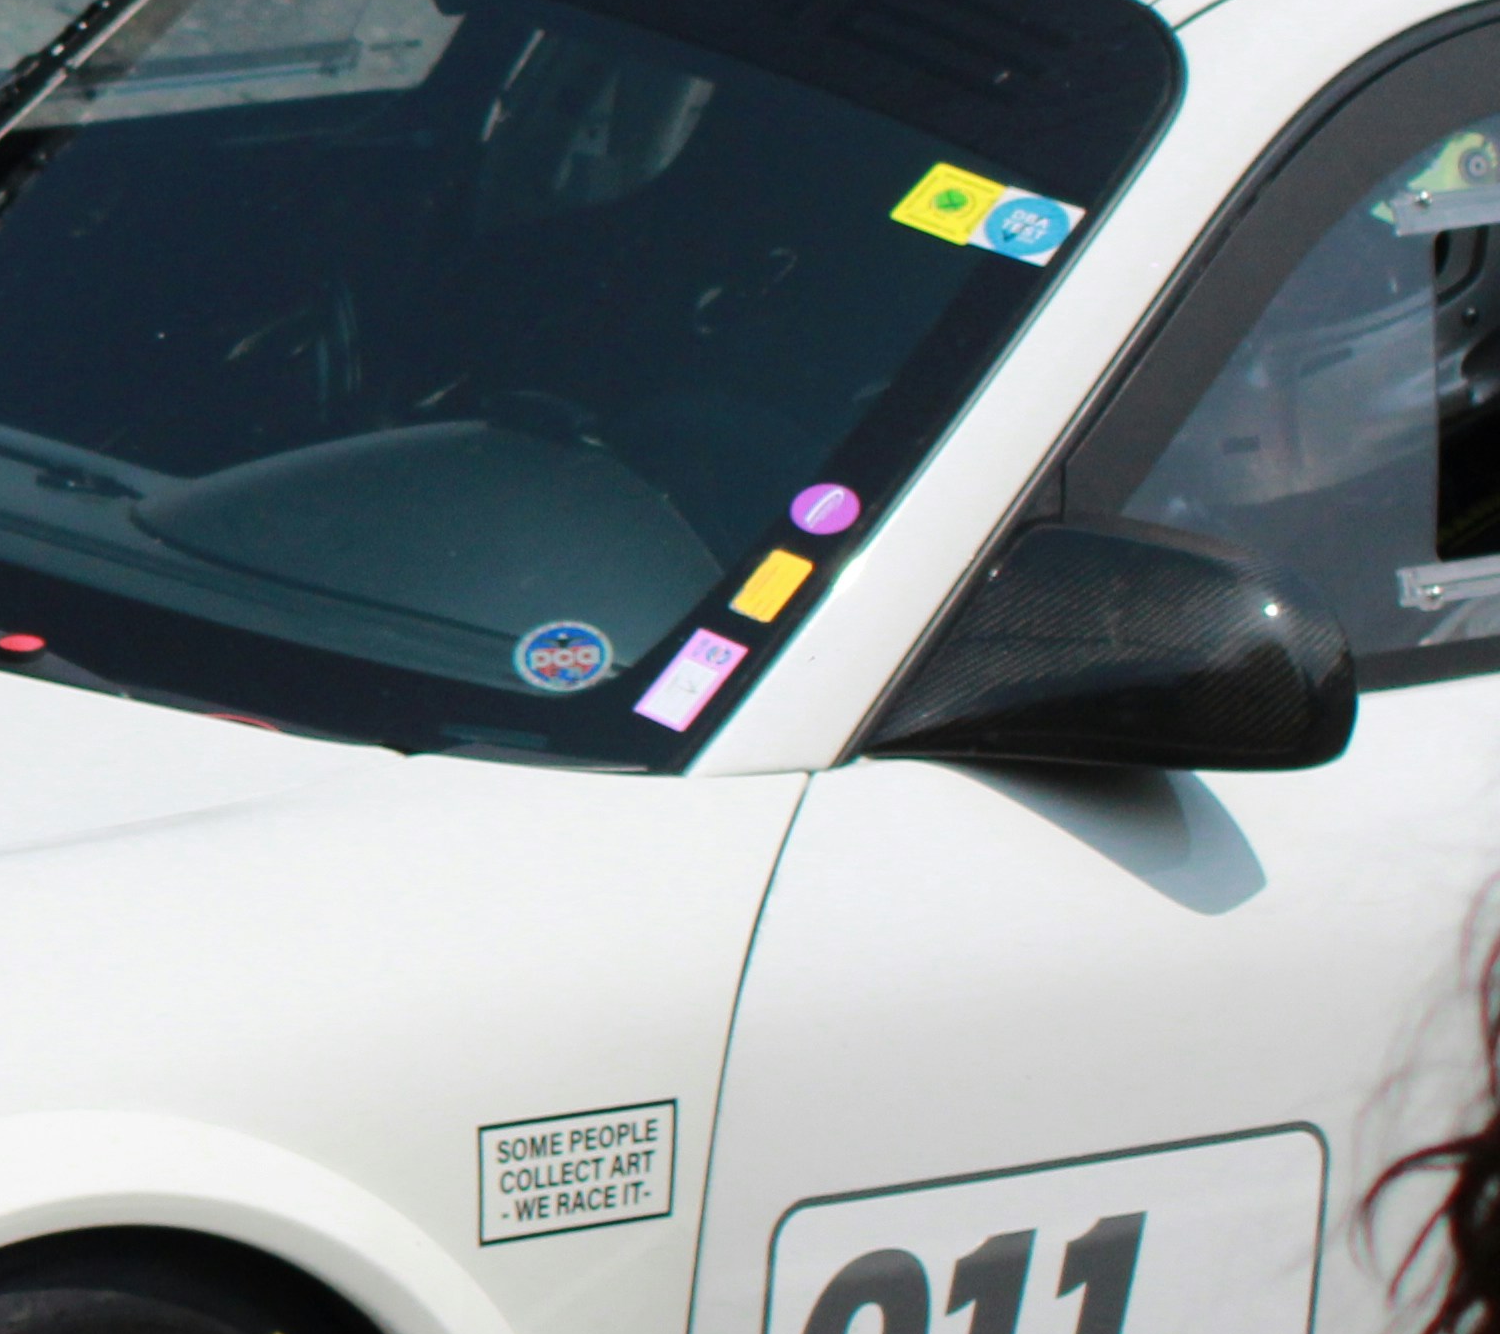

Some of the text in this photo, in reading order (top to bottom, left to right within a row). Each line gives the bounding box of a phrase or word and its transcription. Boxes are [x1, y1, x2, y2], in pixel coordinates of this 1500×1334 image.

[497, 1118, 658, 1164] SOME PEOPLE
[500, 1150, 656, 1195] COLLECT ART
[514, 1195, 550, 1222] WE
[556, 1185, 617, 1216] RACE
